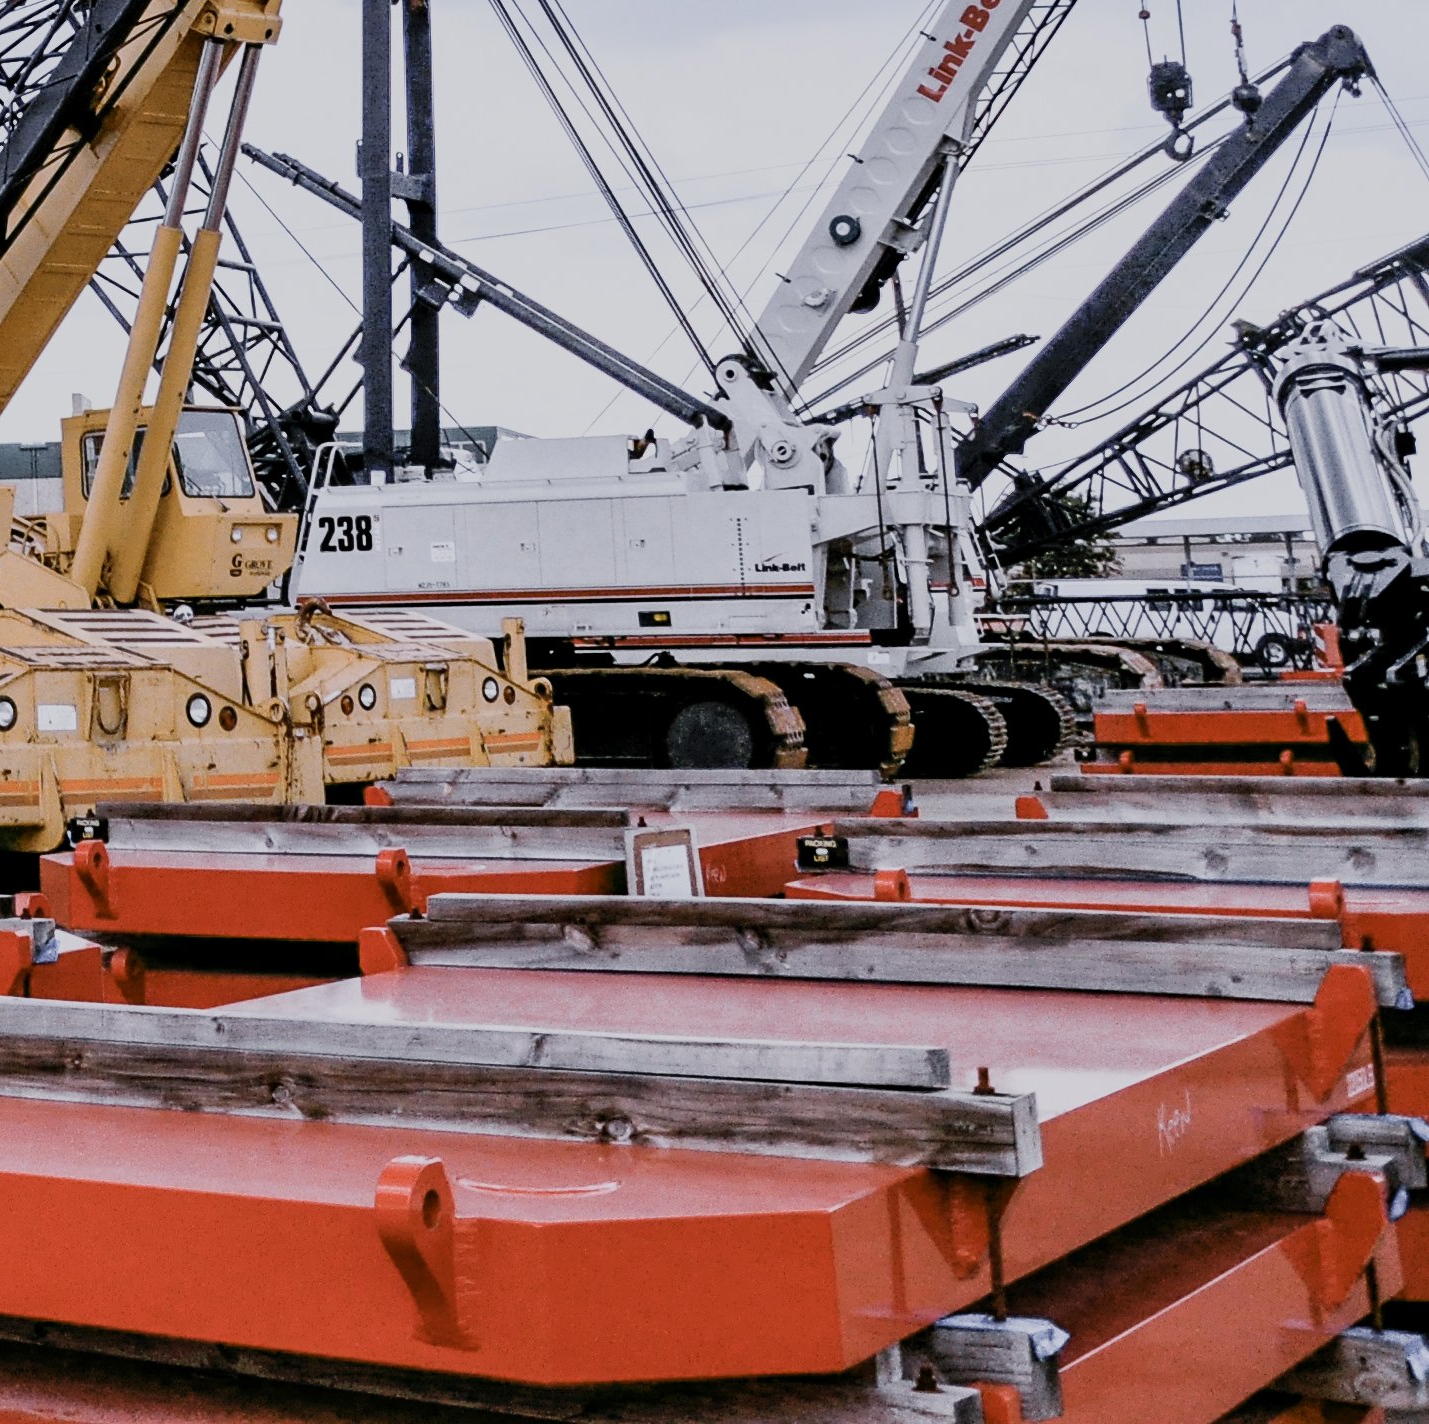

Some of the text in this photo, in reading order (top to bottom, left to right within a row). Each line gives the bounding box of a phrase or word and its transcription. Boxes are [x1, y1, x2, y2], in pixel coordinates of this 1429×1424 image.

[319, 515, 373, 552] 238
[754, 563, 806, 573] Link-Belt
[804, 839, 838, 849] PACKING
